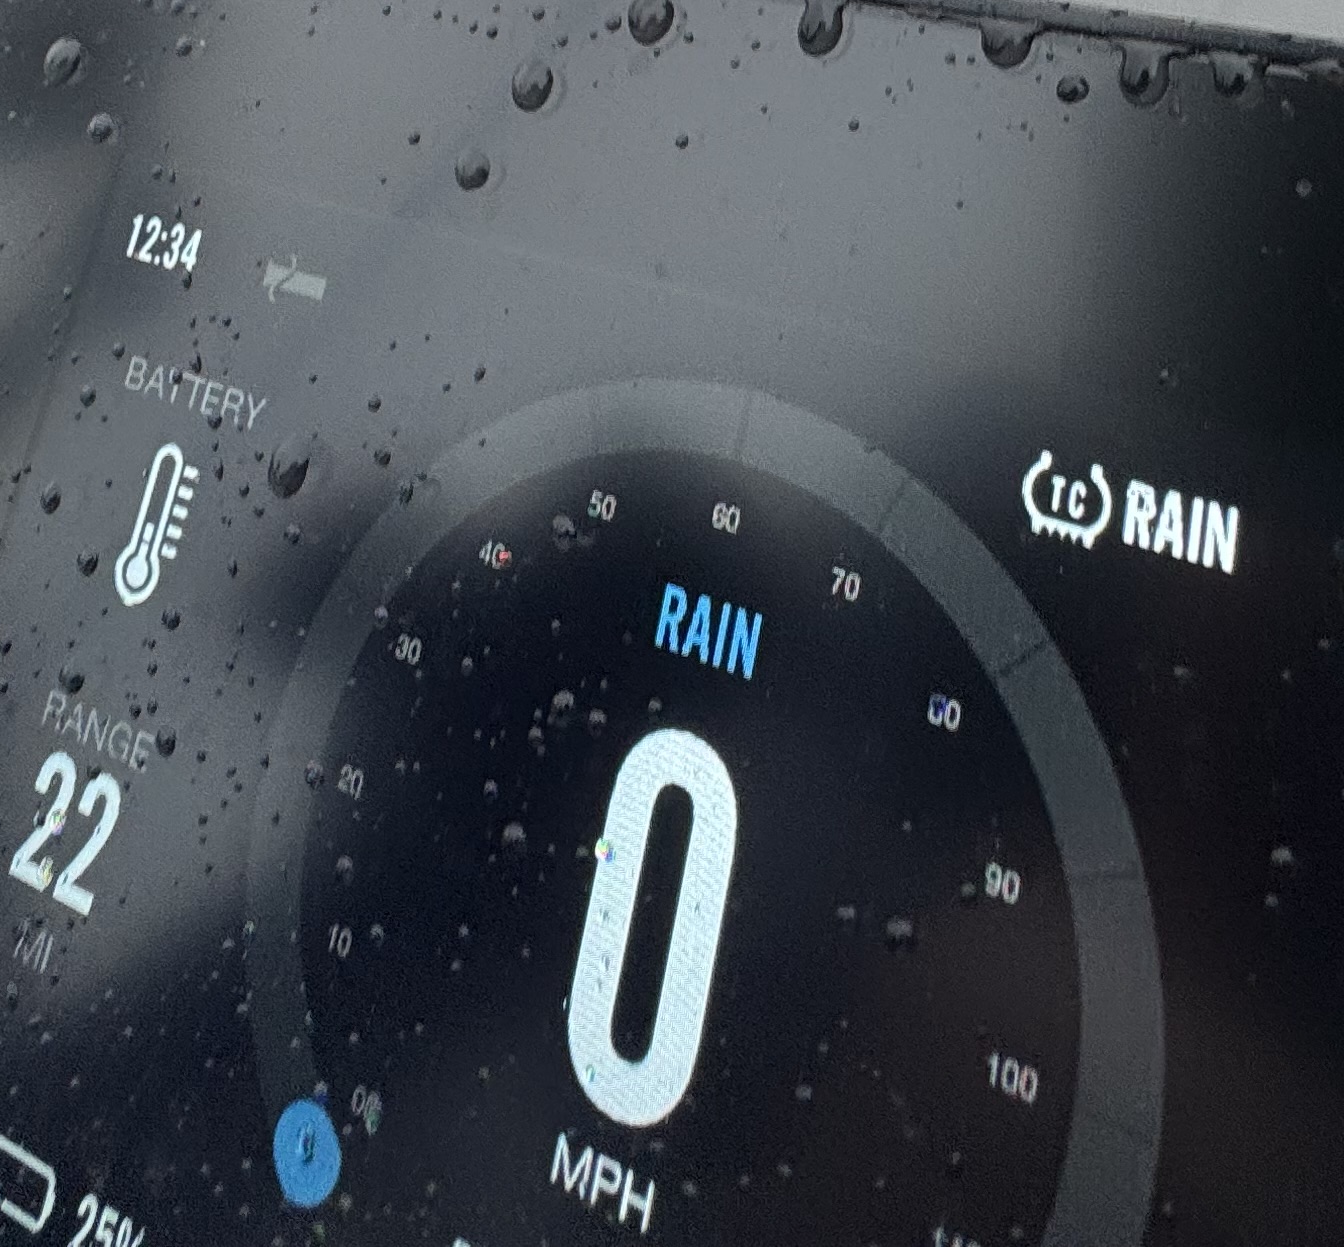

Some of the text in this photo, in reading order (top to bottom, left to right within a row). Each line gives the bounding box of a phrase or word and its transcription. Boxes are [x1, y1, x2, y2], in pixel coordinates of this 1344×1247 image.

[126, 213, 202, 272] 12:34
[125, 355, 267, 430] BATTERY
[587, 489, 617, 522] 50
[712, 502, 740, 534] 60
[1051, 474, 1240, 575] TC RAIN
[478, 539, 513, 570] 40
[830, 566, 861, 602] 70
[394, 632, 423, 666] 30
[656, 583, 763, 680] RAIN
[41, 688, 156, 773] RANGE
[336, 763, 365, 798] 20
[9, 751, 121, 916] 22
[984, 863, 1021, 905] 90
[14, 916, 54, 974] MI
[327, 923, 354, 958] 10
[567, 729, 737, 1128] 0
[987, 1052, 1039, 1104] 100
[550, 1133, 656, 1235] MPH
